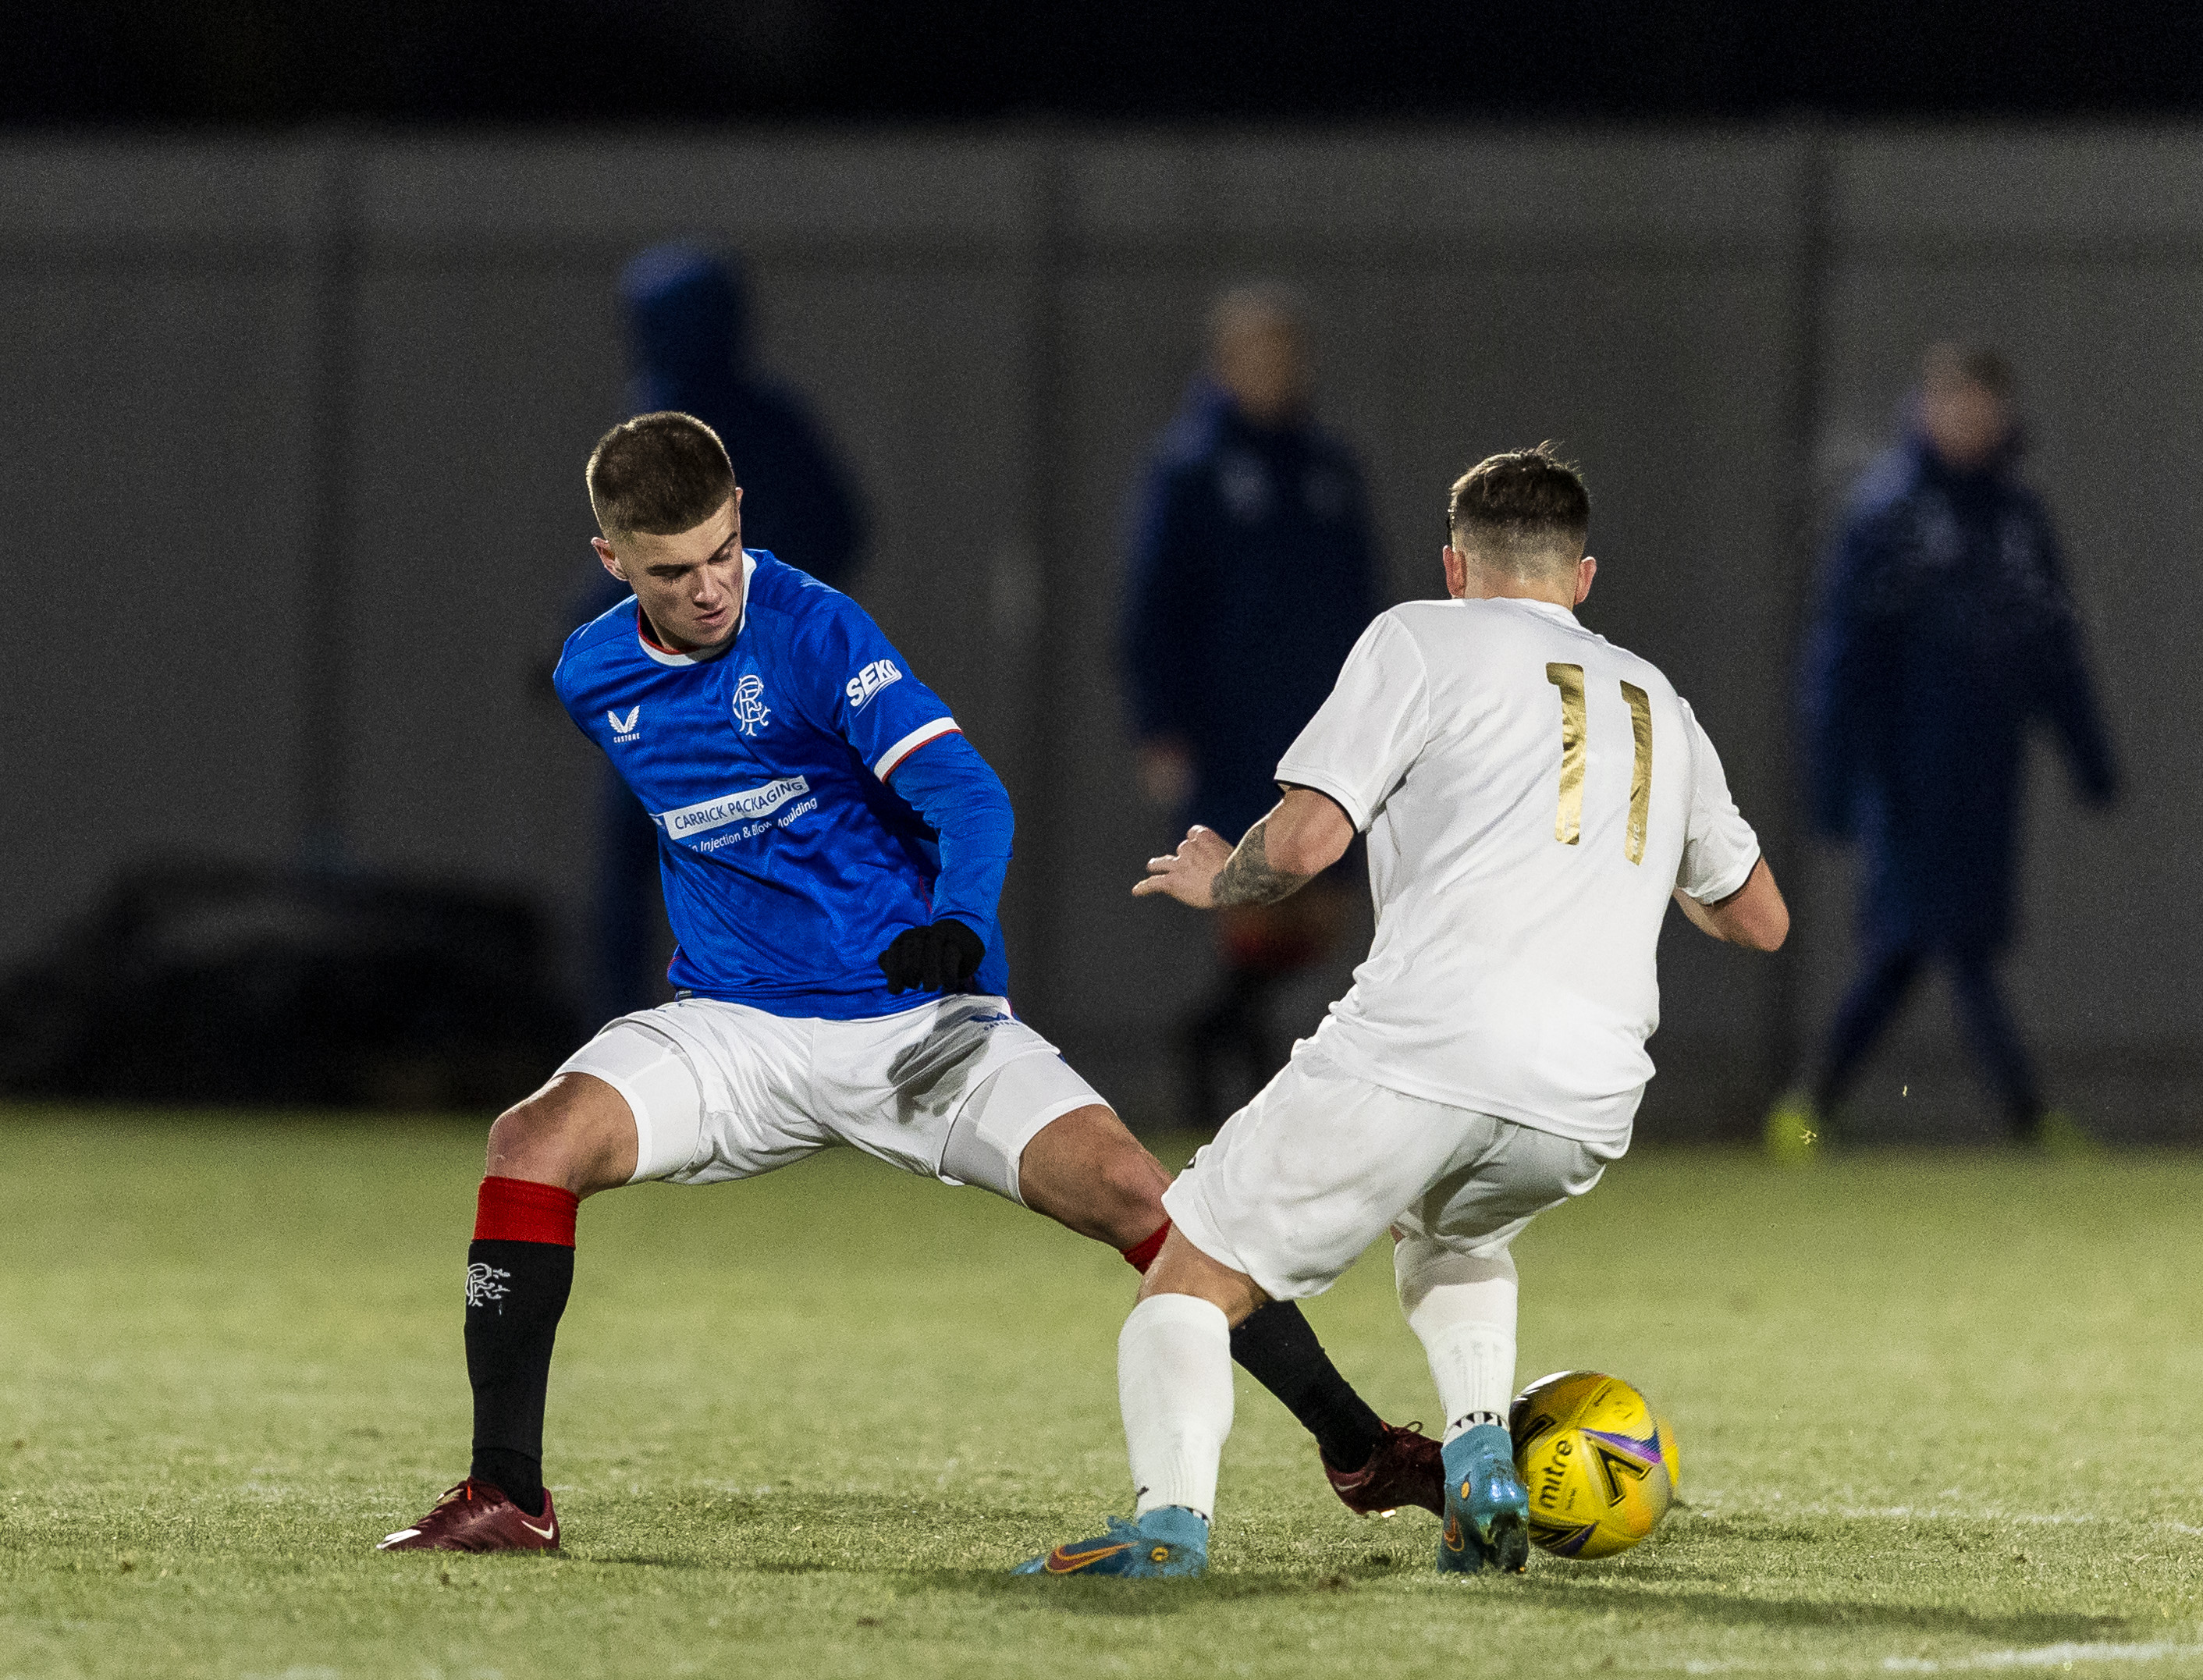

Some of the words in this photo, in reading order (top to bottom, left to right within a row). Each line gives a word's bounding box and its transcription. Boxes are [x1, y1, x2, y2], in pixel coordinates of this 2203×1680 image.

[846, 659, 901, 707] SEKO
[613, 732, 641, 744] CASTORE
[1545, 662, 1654, 866] 11
[674, 804, 729, 829] CARRICK
[727, 781, 804, 815] PACKAGING
[700, 833, 741, 852] Injection
[742, 826, 752, 838] &
[1539, 1440, 1573, 1509] mitre
